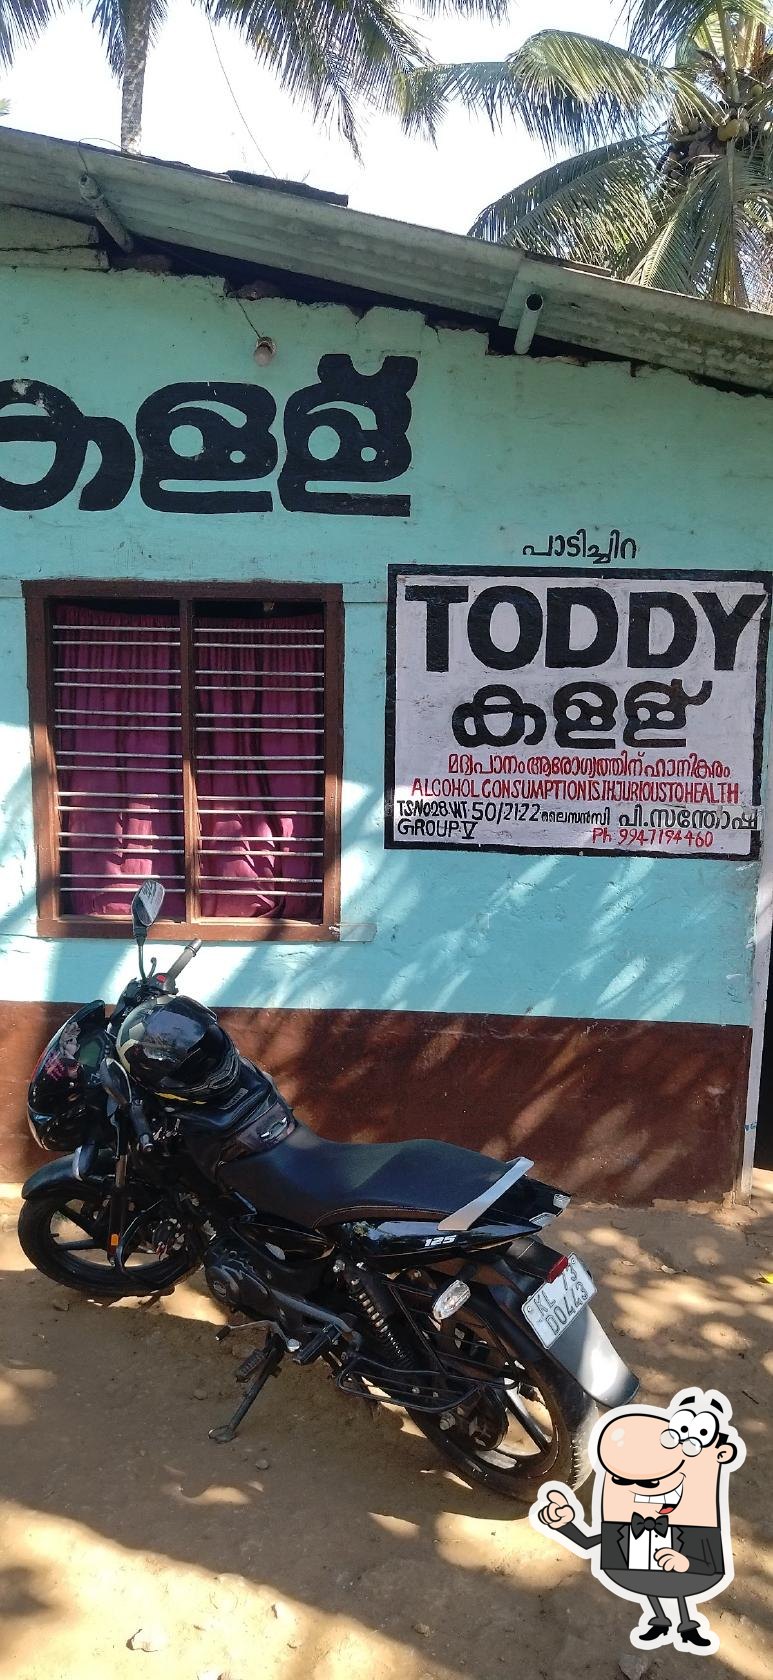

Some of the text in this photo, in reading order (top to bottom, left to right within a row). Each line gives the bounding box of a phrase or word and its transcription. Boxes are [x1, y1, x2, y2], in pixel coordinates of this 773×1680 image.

[522, 528, 637, 564] പാടിച്ചിറ
[404, 584, 766, 672] TODDY
[412, 778, 480, 798] ALCOHOL
[481, 780, 586, 801] CONSUMPTION
[587, 779, 601, 801] IS
[664, 782, 682, 803] TO
[684, 782, 739, 804] HEALTH
[618, 829, 714, 848] 9947194460
[424, 1234, 457, 1247] 125
[534, 1290, 556, 1317] KL
